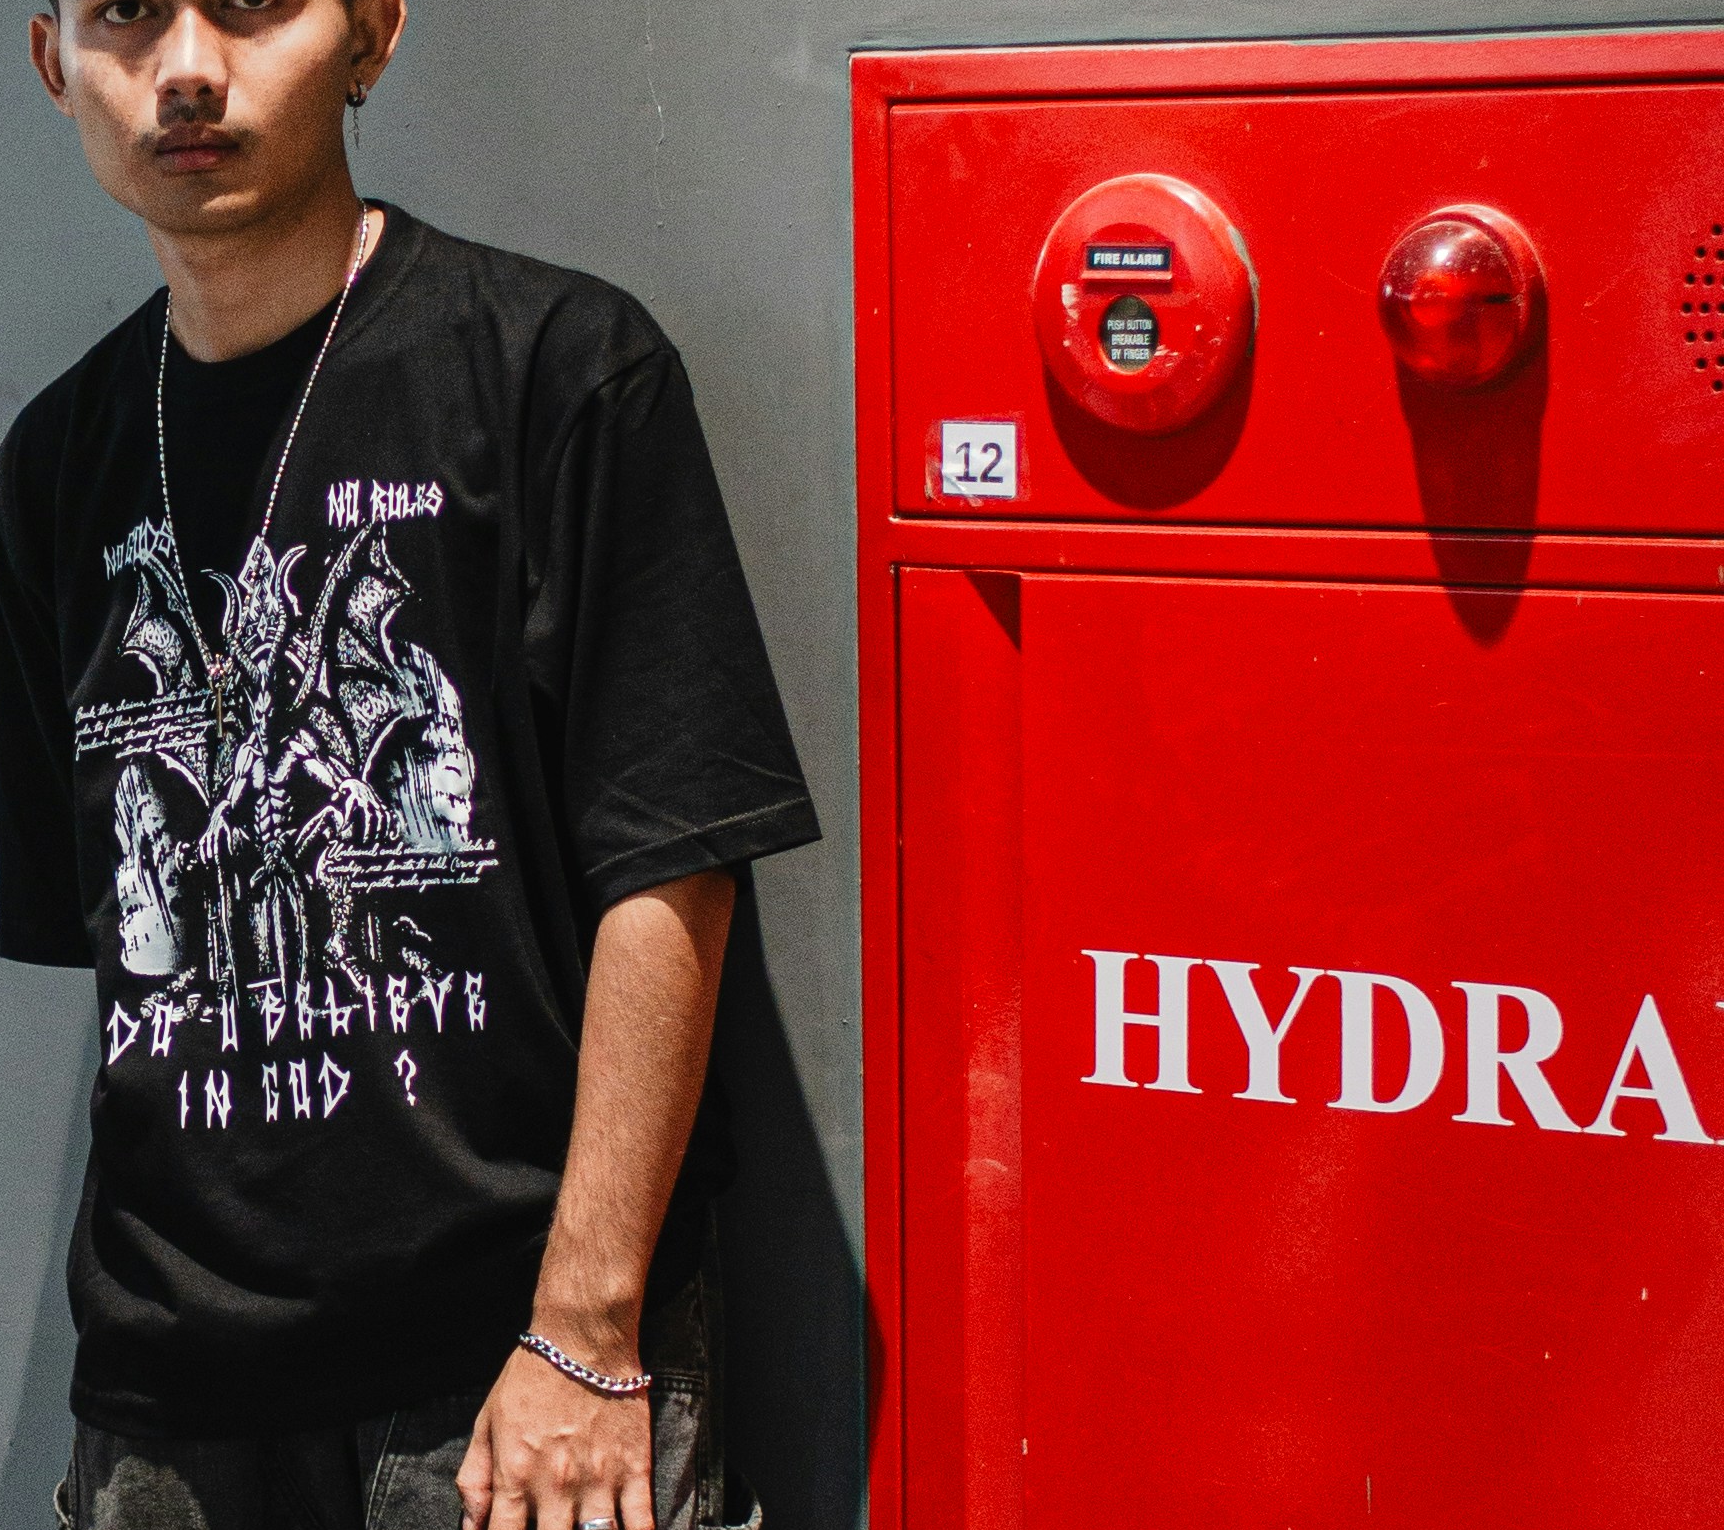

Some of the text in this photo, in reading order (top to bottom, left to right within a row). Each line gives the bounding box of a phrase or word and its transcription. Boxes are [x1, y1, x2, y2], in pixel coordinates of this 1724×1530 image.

[1093, 252, 1164, 266] FIRE ALARM
[1107, 319, 1153, 330] PUSH BUTTON
[1111, 334, 1151, 346] BREAKABLE
[1111, 348, 1150, 360] BY FINGER
[955, 441, 1004, 483] 12
[328, 479, 444, 527] NO RULES
[106, 1000, 174, 1066] DO
[1081, 949, 1724, 1145] HYDRA
[178, 1049, 417, 1129] IN GOD ?
